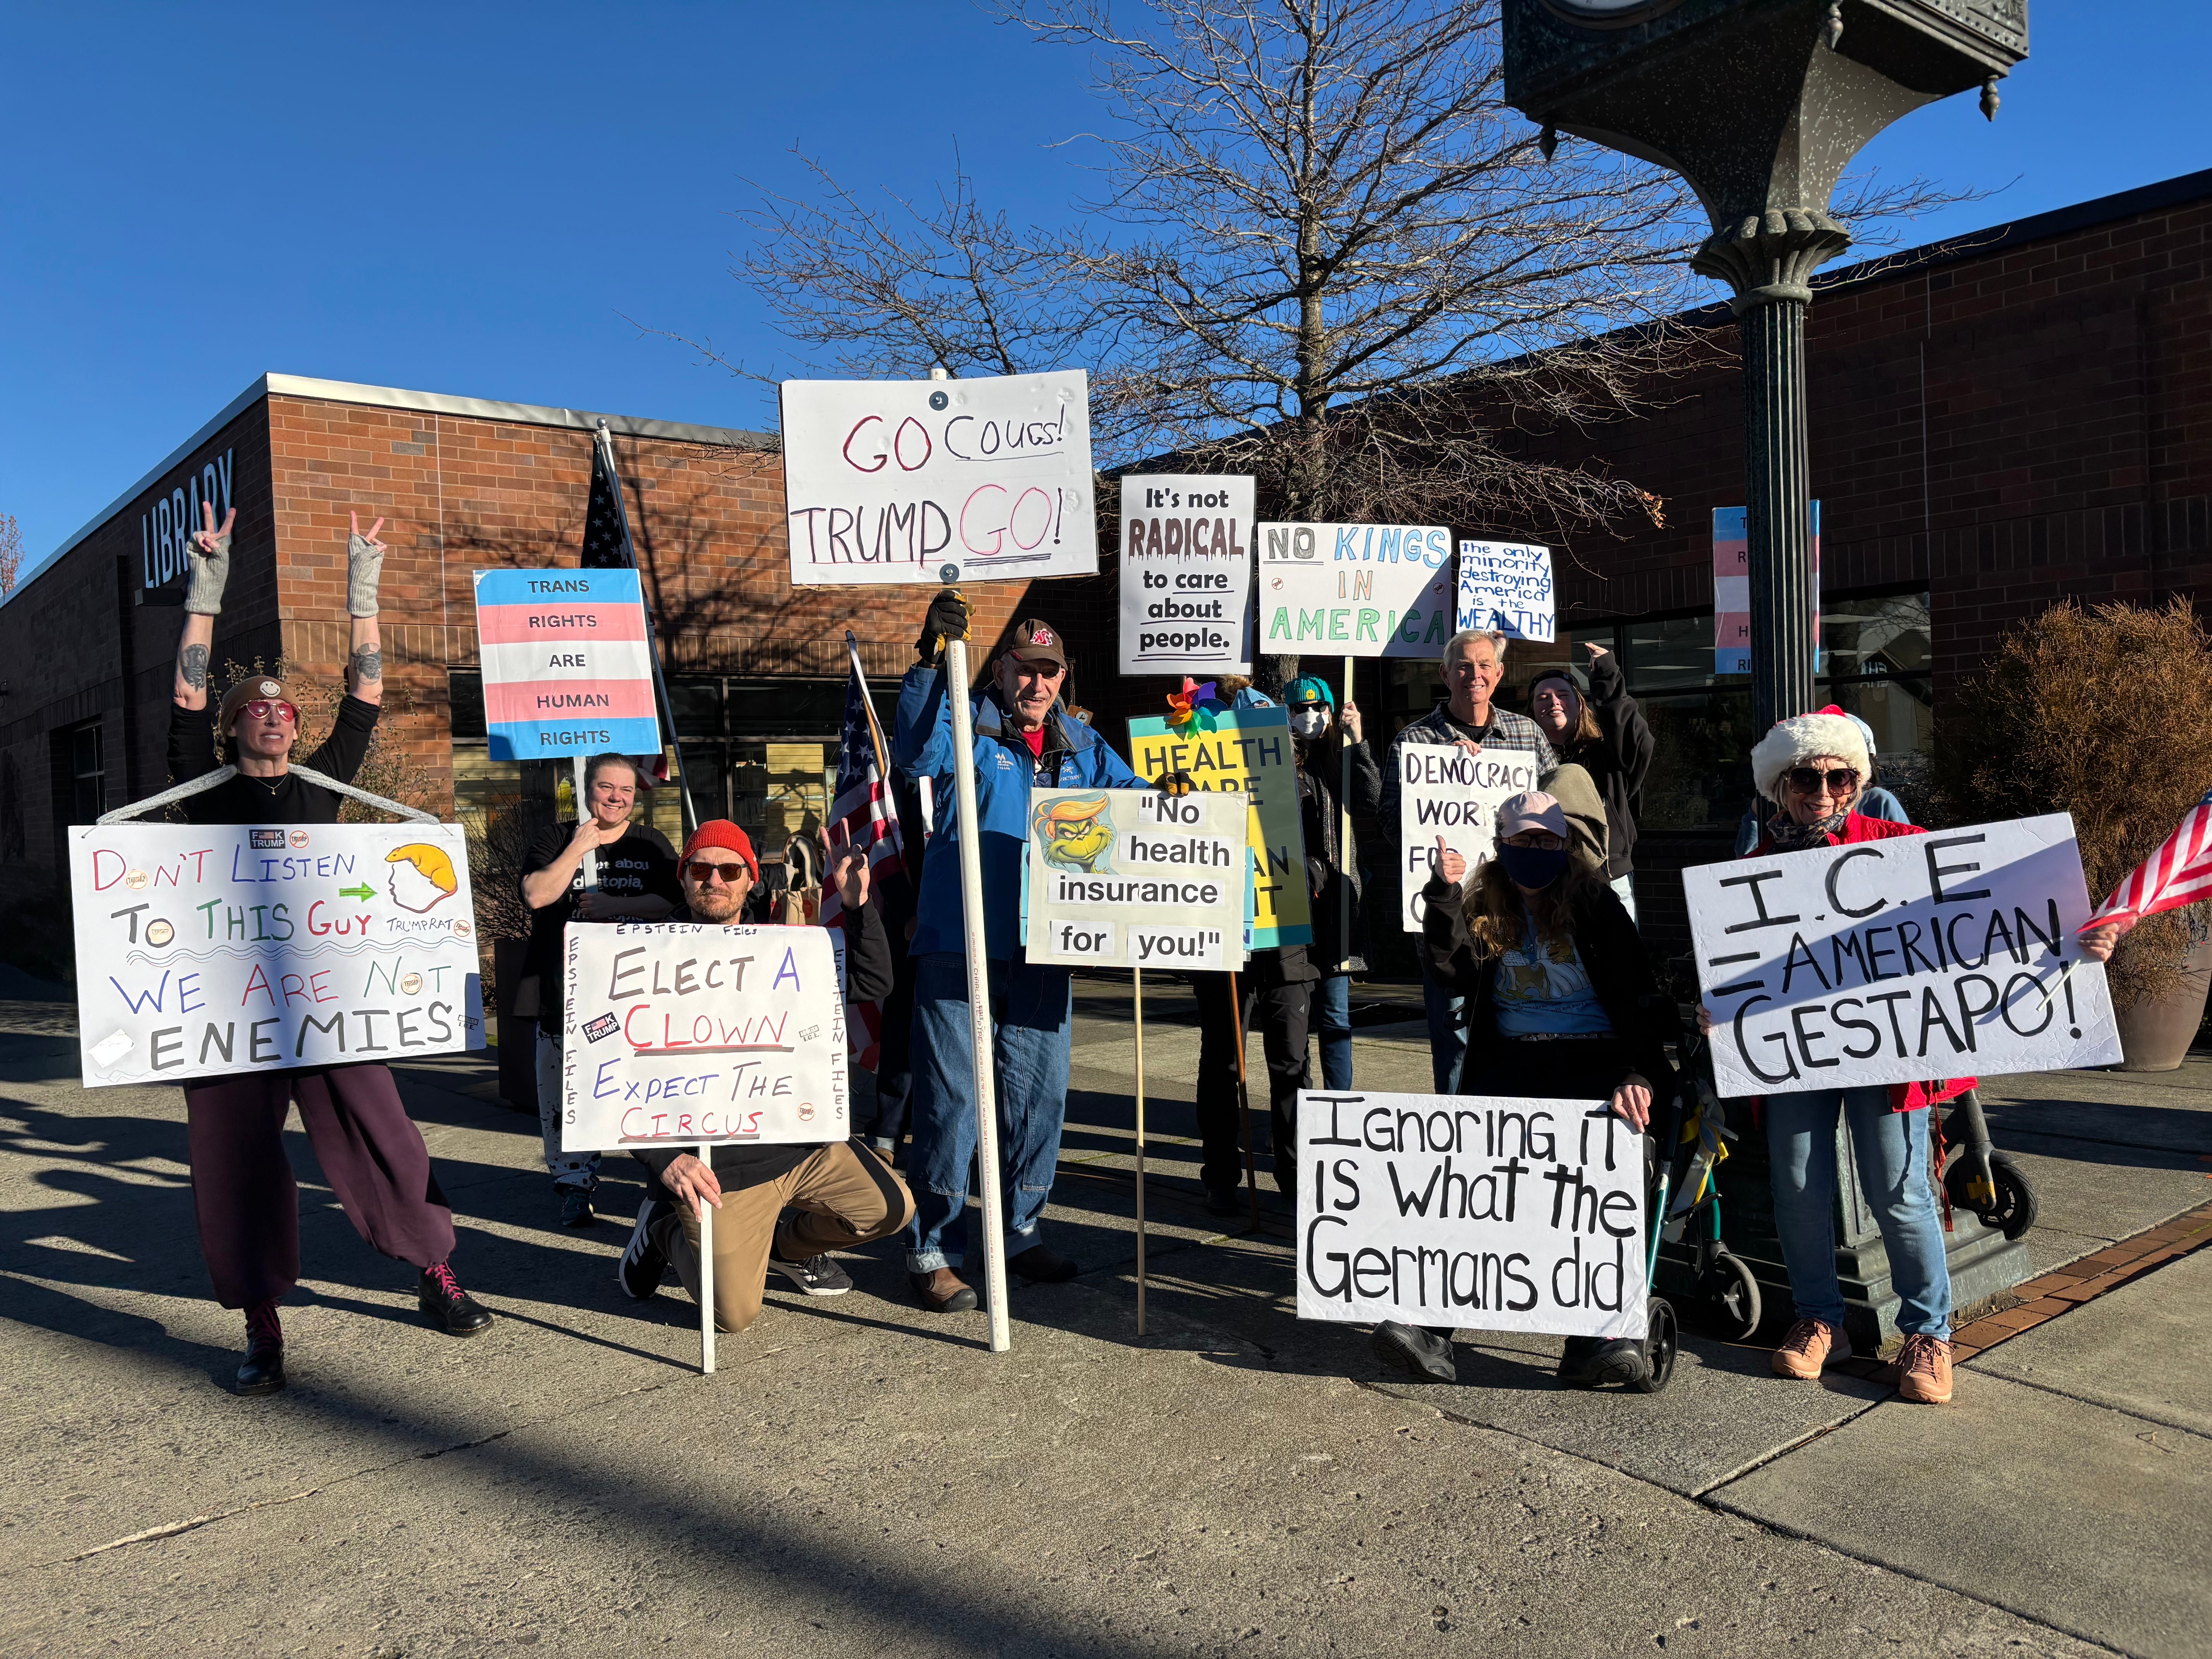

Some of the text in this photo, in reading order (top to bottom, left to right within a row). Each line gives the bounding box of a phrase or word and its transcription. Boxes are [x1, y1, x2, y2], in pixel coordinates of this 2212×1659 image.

[842, 416, 932, 472] GO
[1146, 488, 1229, 508] It's not
[143, 448, 232, 588] LIBRARY
[790, 484, 1063, 570] TRUMP GO!
[1128, 518, 1244, 566] RADICAL
[1268, 527, 1446, 568] NO KINGS
[1461, 543, 1542, 561] the only
[1143, 570, 1228, 589] to care
[1460, 566, 1551, 593] destroying
[1462, 554, 1549, 577] minority
[527, 580, 589, 593] TRANS
[1338, 570, 1373, 601] IN
[1461, 580, 1545, 601] America
[1148, 598, 1222, 618] about
[1473, 595, 1524, 609] is the
[529, 615, 597, 628] RIGHTS
[1269, 607, 1445, 645] AMERICA
[1458, 607, 1554, 637] WEALTHY
[1140, 627, 1230, 651] people.
[549, 654, 586, 667] ARE
[537, 694, 609, 708] HUMAN
[540, 730, 611, 745] RIGHTS
[1144, 737, 1282, 776] HEALTH
[1406, 753, 1533, 792] DEMOCRACY
[1142, 796, 1199, 824] "No
[232, 844, 355, 883] LISTEN
[615, 858, 649, 870] abou
[1130, 835, 1230, 866] health
[573, 874, 643, 890] dstopia,
[1059, 875, 1218, 903] insurance
[111, 898, 372, 948] TO THIS GUY
[617, 924, 702, 934] EPSTEIN
[1061, 925, 1107, 952] for
[1138, 931, 1220, 960] you!"
[109, 956, 451, 1014] WE ARE NOT
[608, 946, 800, 1001] ELECT A
[150, 1001, 452, 1071] ENEMIES
[565, 936, 579, 1125] EPSTEIN FILES
[587, 1022, 617, 1041] TRUMP
[624, 1005, 788, 1048] CLOWN
[832, 948, 845, 1119] EPSTEIN FILES
[1733, 961, 2082, 1084] GESTAPO!
[593, 1058, 792, 1104] EXPECT THE
[620, 1107, 763, 1138] CIRCUS
[1543, 1163, 1637, 1238] the
[1306, 1214, 1624, 1313] Germans did
